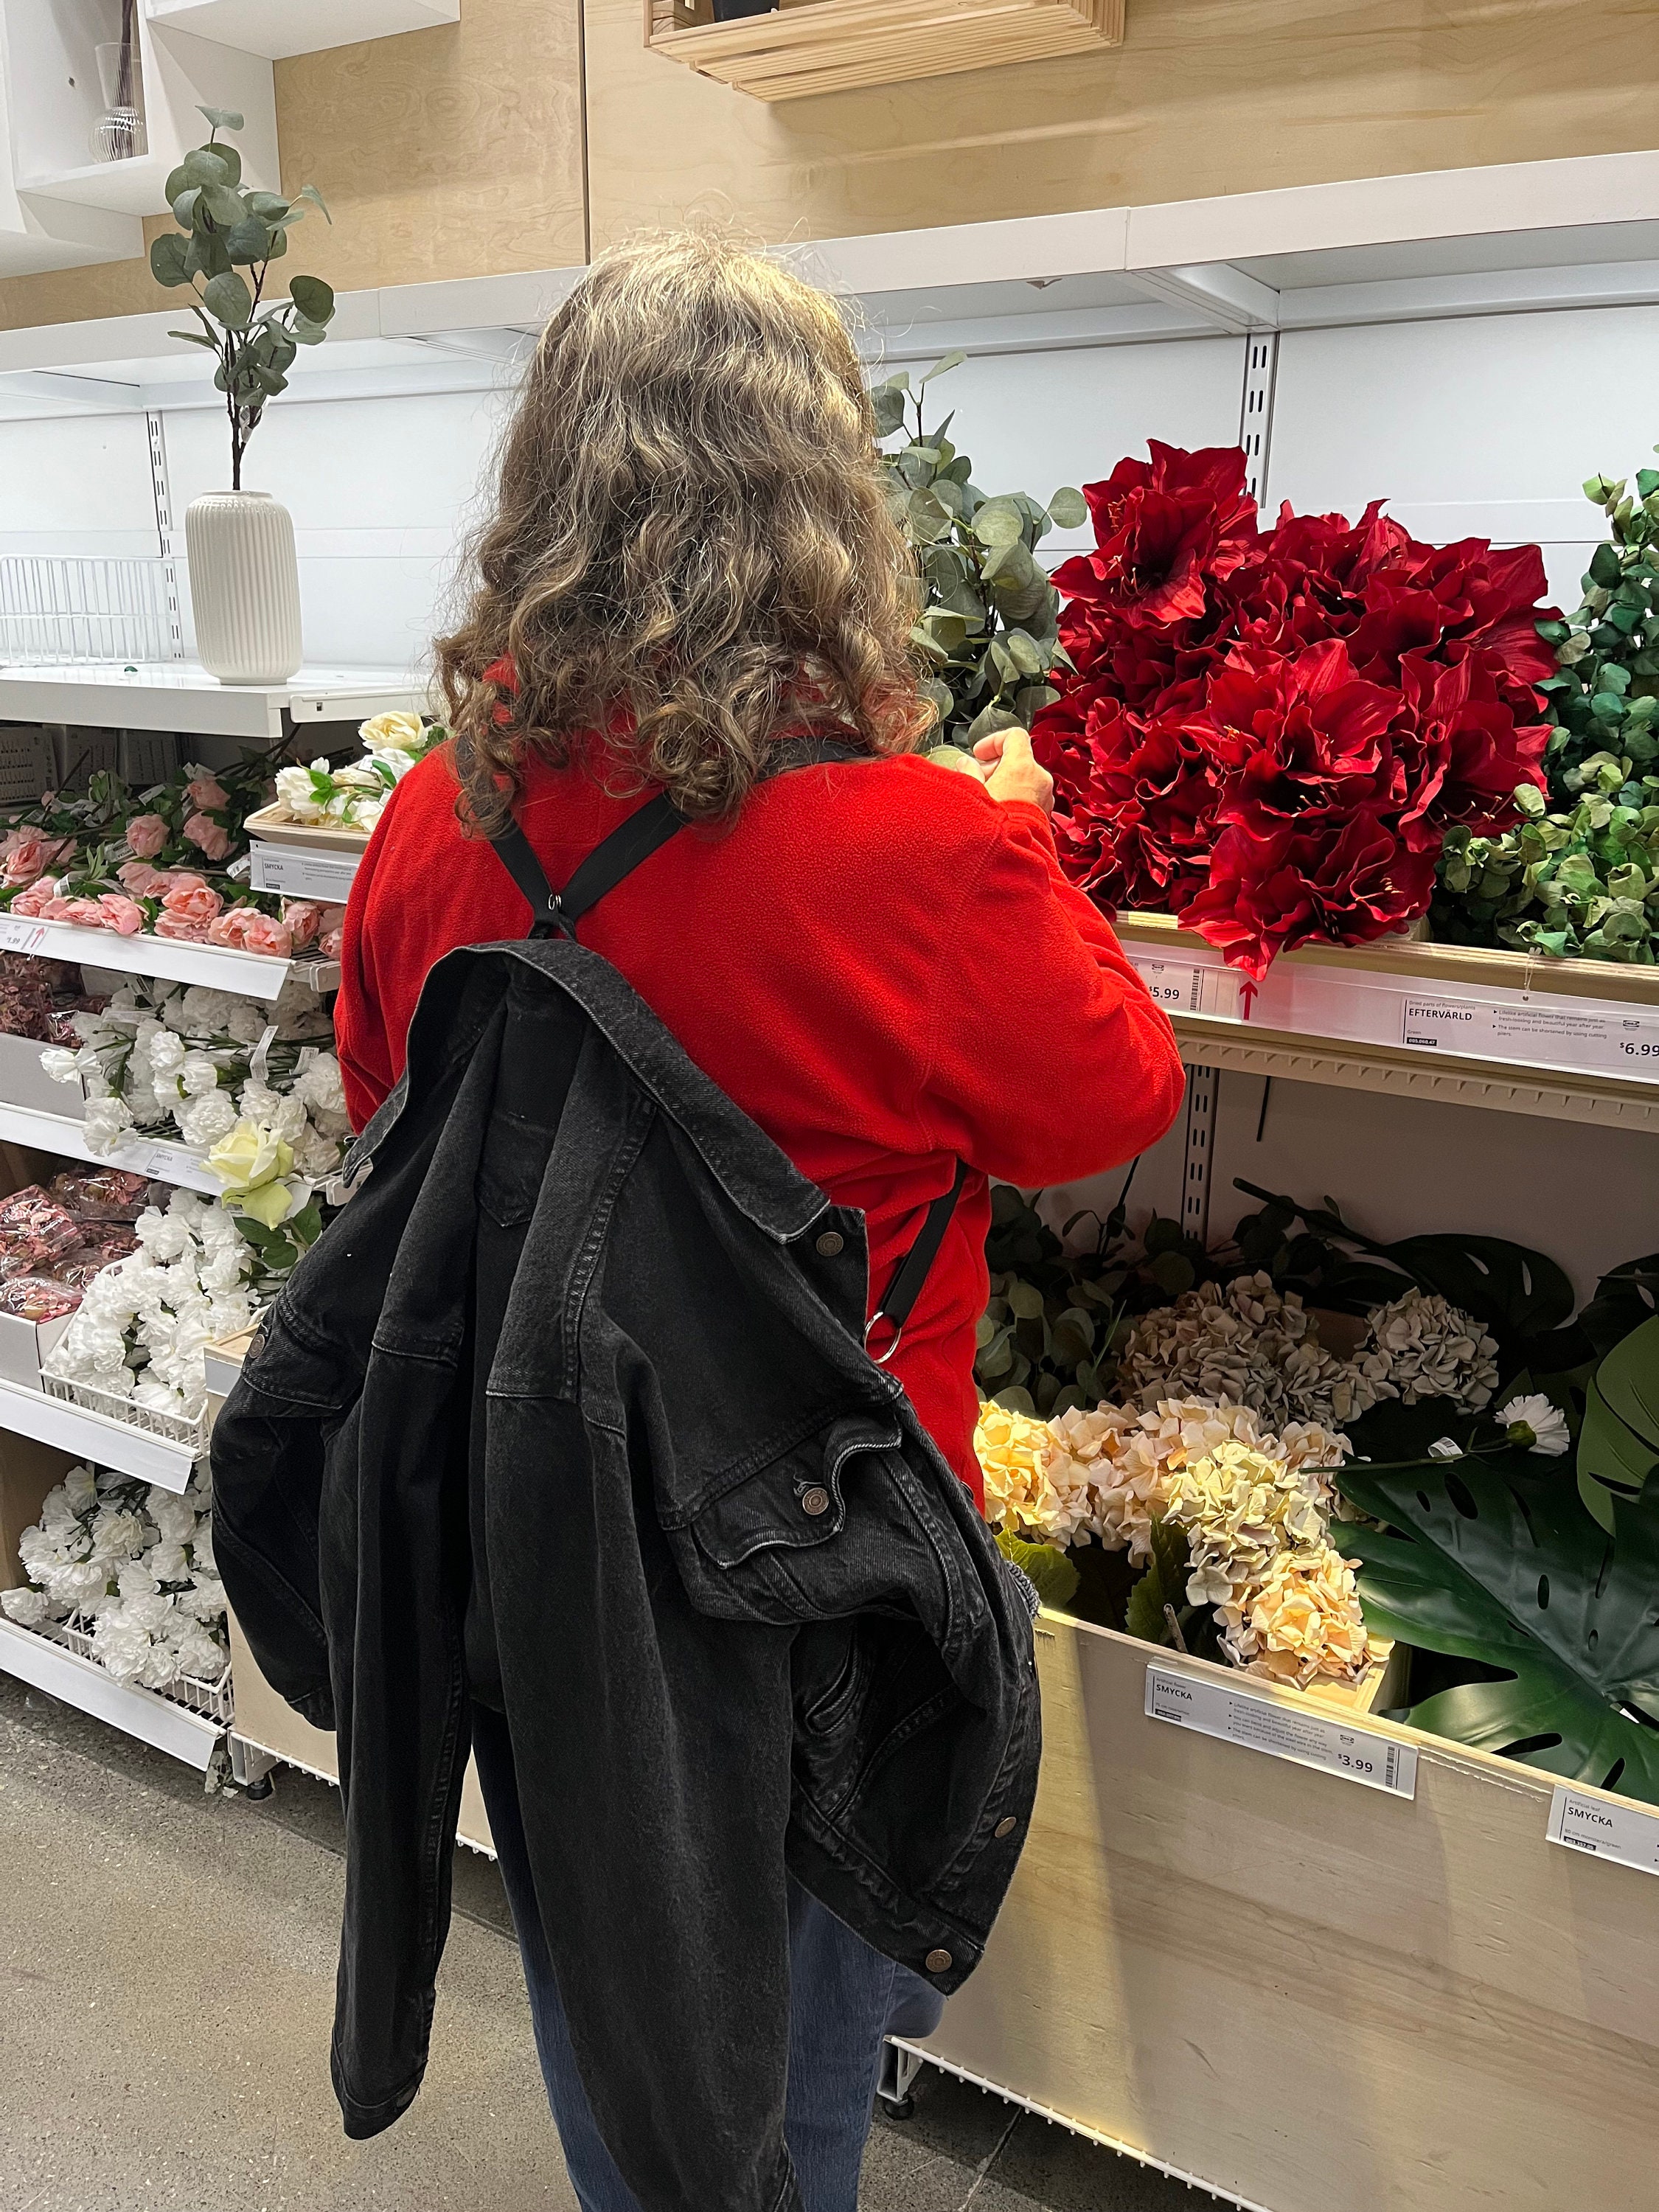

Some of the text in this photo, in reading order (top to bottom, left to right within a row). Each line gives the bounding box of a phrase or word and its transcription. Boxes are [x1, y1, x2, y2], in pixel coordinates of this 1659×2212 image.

[264, 863, 284, 871] SMYCKA
[1149, 986, 1180, 1000] $5.99
[1408, 1008, 1472, 1020] EFTERVÄRLD
[1619, 1042, 1659, 1057] $6.99
[1156, 1684, 1192, 1701] SMYCKA
[1338, 1753, 1373, 1773] $3.99
[1569, 1799, 1590, 1809] Artificial
[1568, 1806, 1613, 1828] SMYCKA
